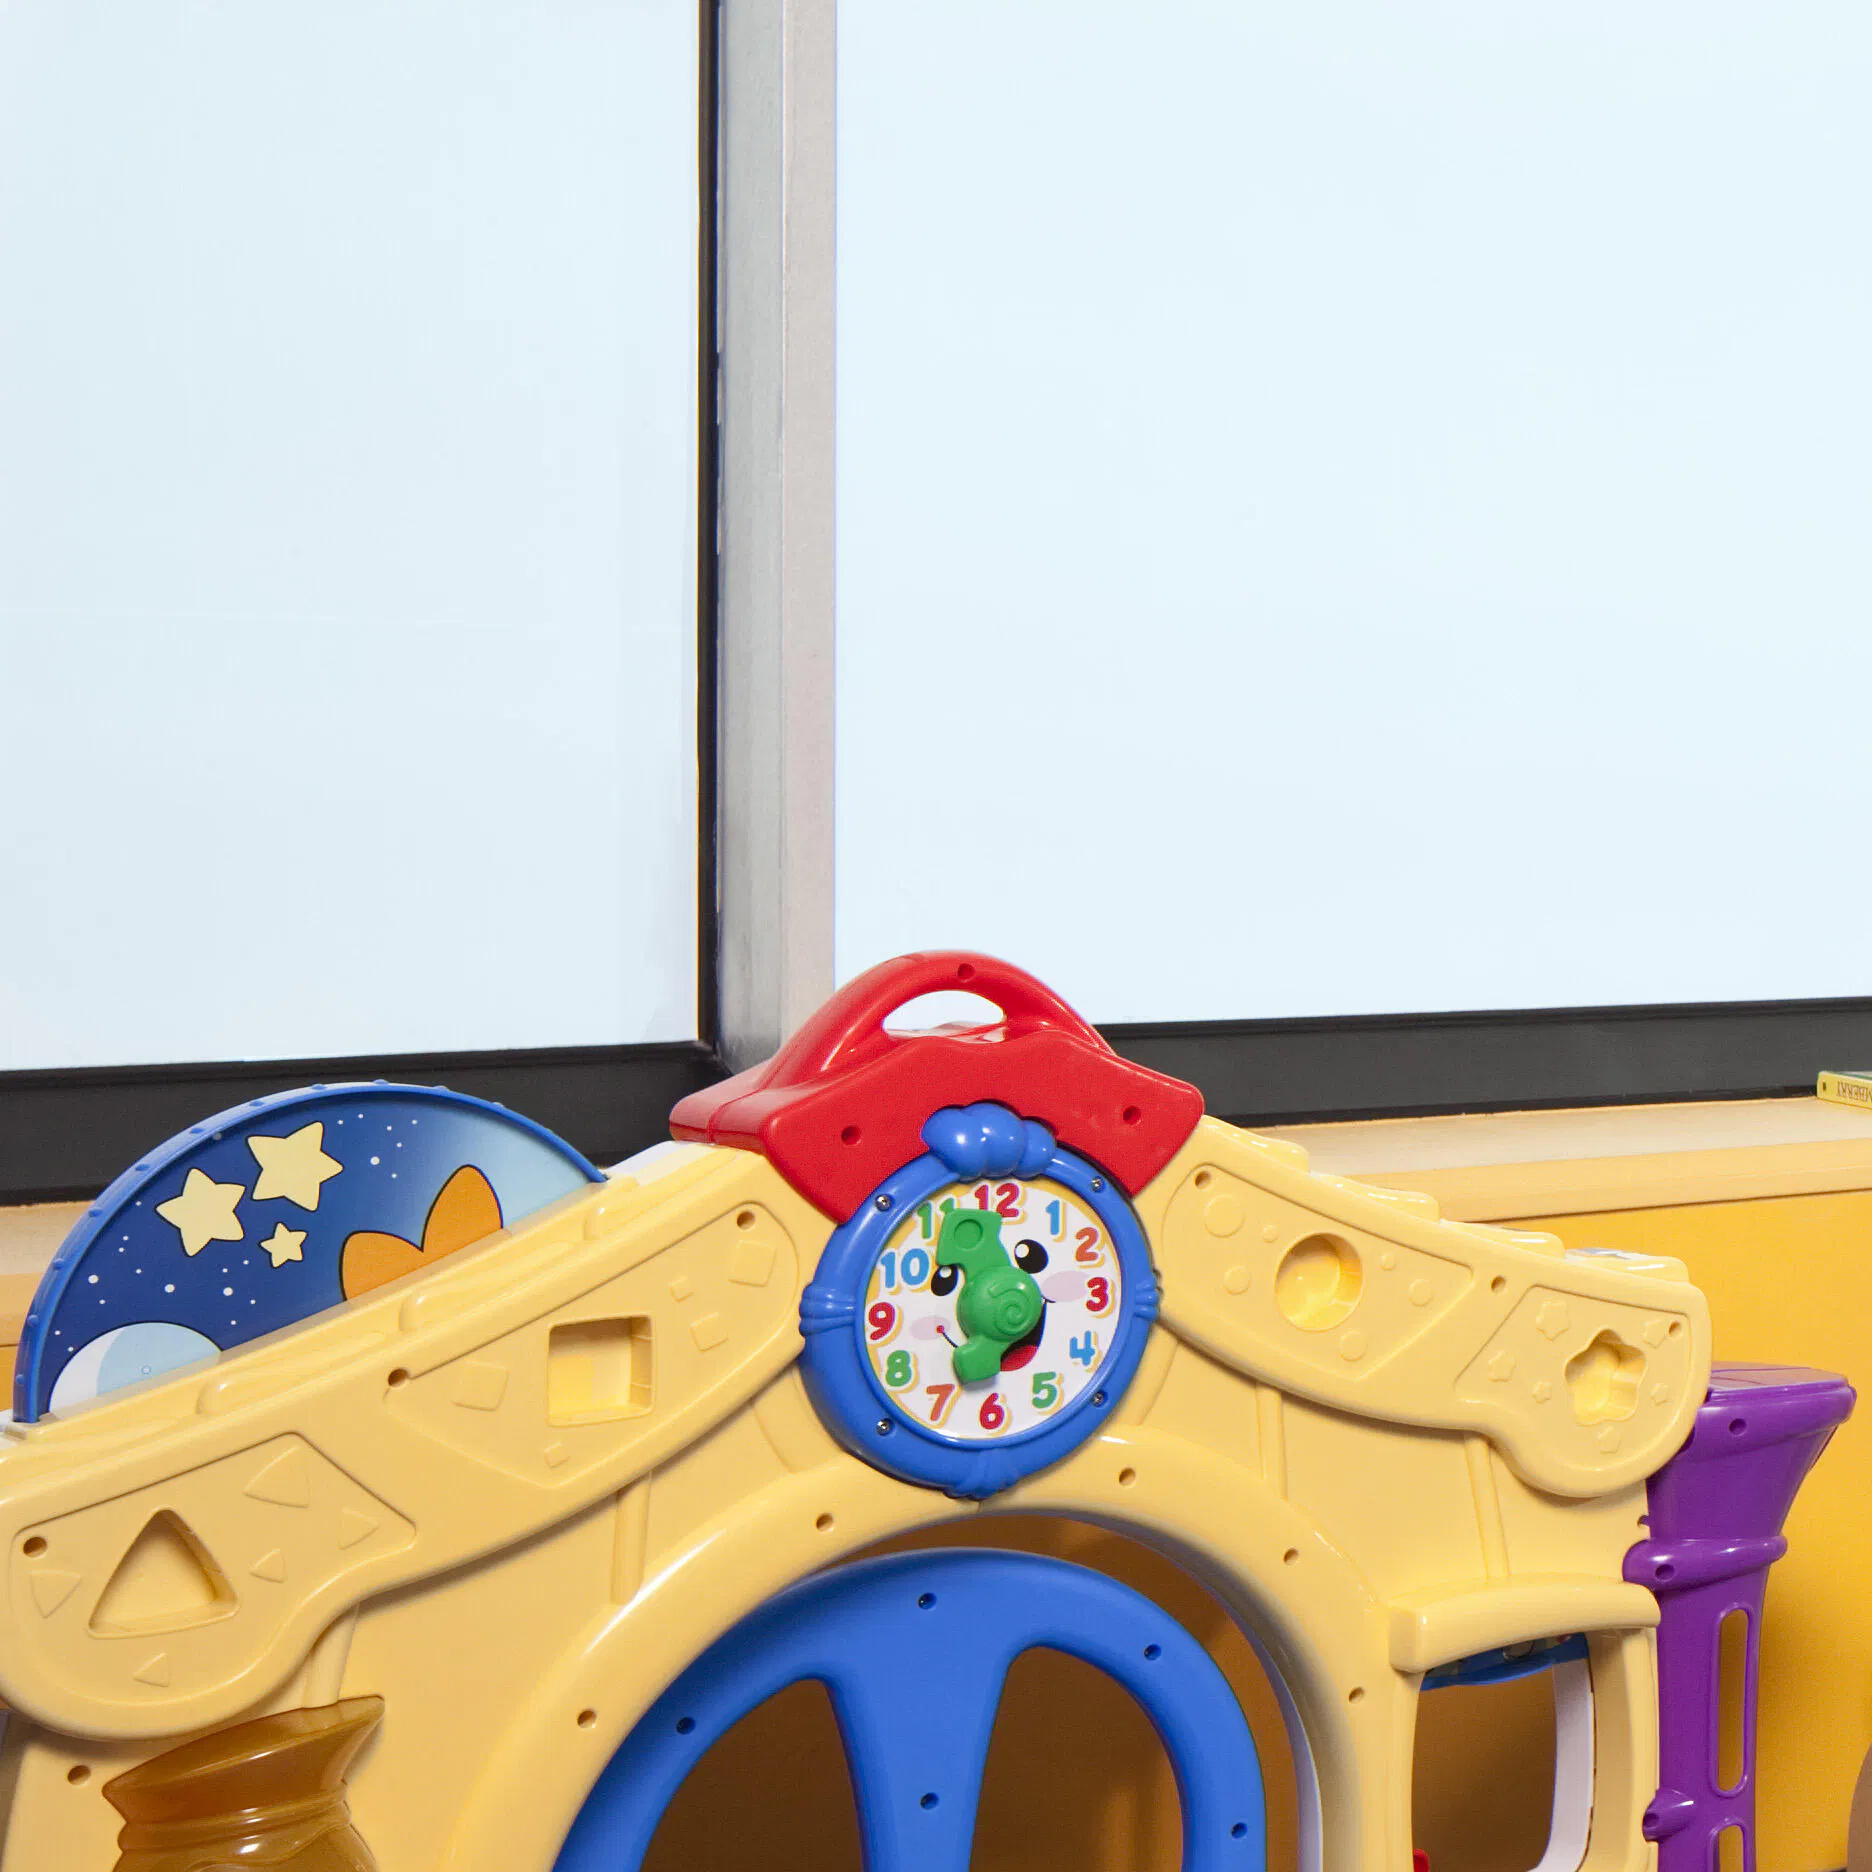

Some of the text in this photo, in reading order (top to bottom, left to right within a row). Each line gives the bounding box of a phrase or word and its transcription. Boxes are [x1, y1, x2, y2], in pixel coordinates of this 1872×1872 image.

[974, 1182, 1020, 1218] 12
[1045, 1200, 1060, 1236] 1
[1075, 1227, 1099, 1261] 2
[880, 1248, 930, 1288] 10
[1086, 1278, 1109, 1311] 3
[868, 1302, 896, 1340] 9
[1070, 1331, 1095, 1366] 4
[887, 1350, 912, 1387] 8
[926, 1384, 955, 1421] 7
[1032, 1372, 1057, 1409] 5
[980, 1393, 1004, 1430] 6
